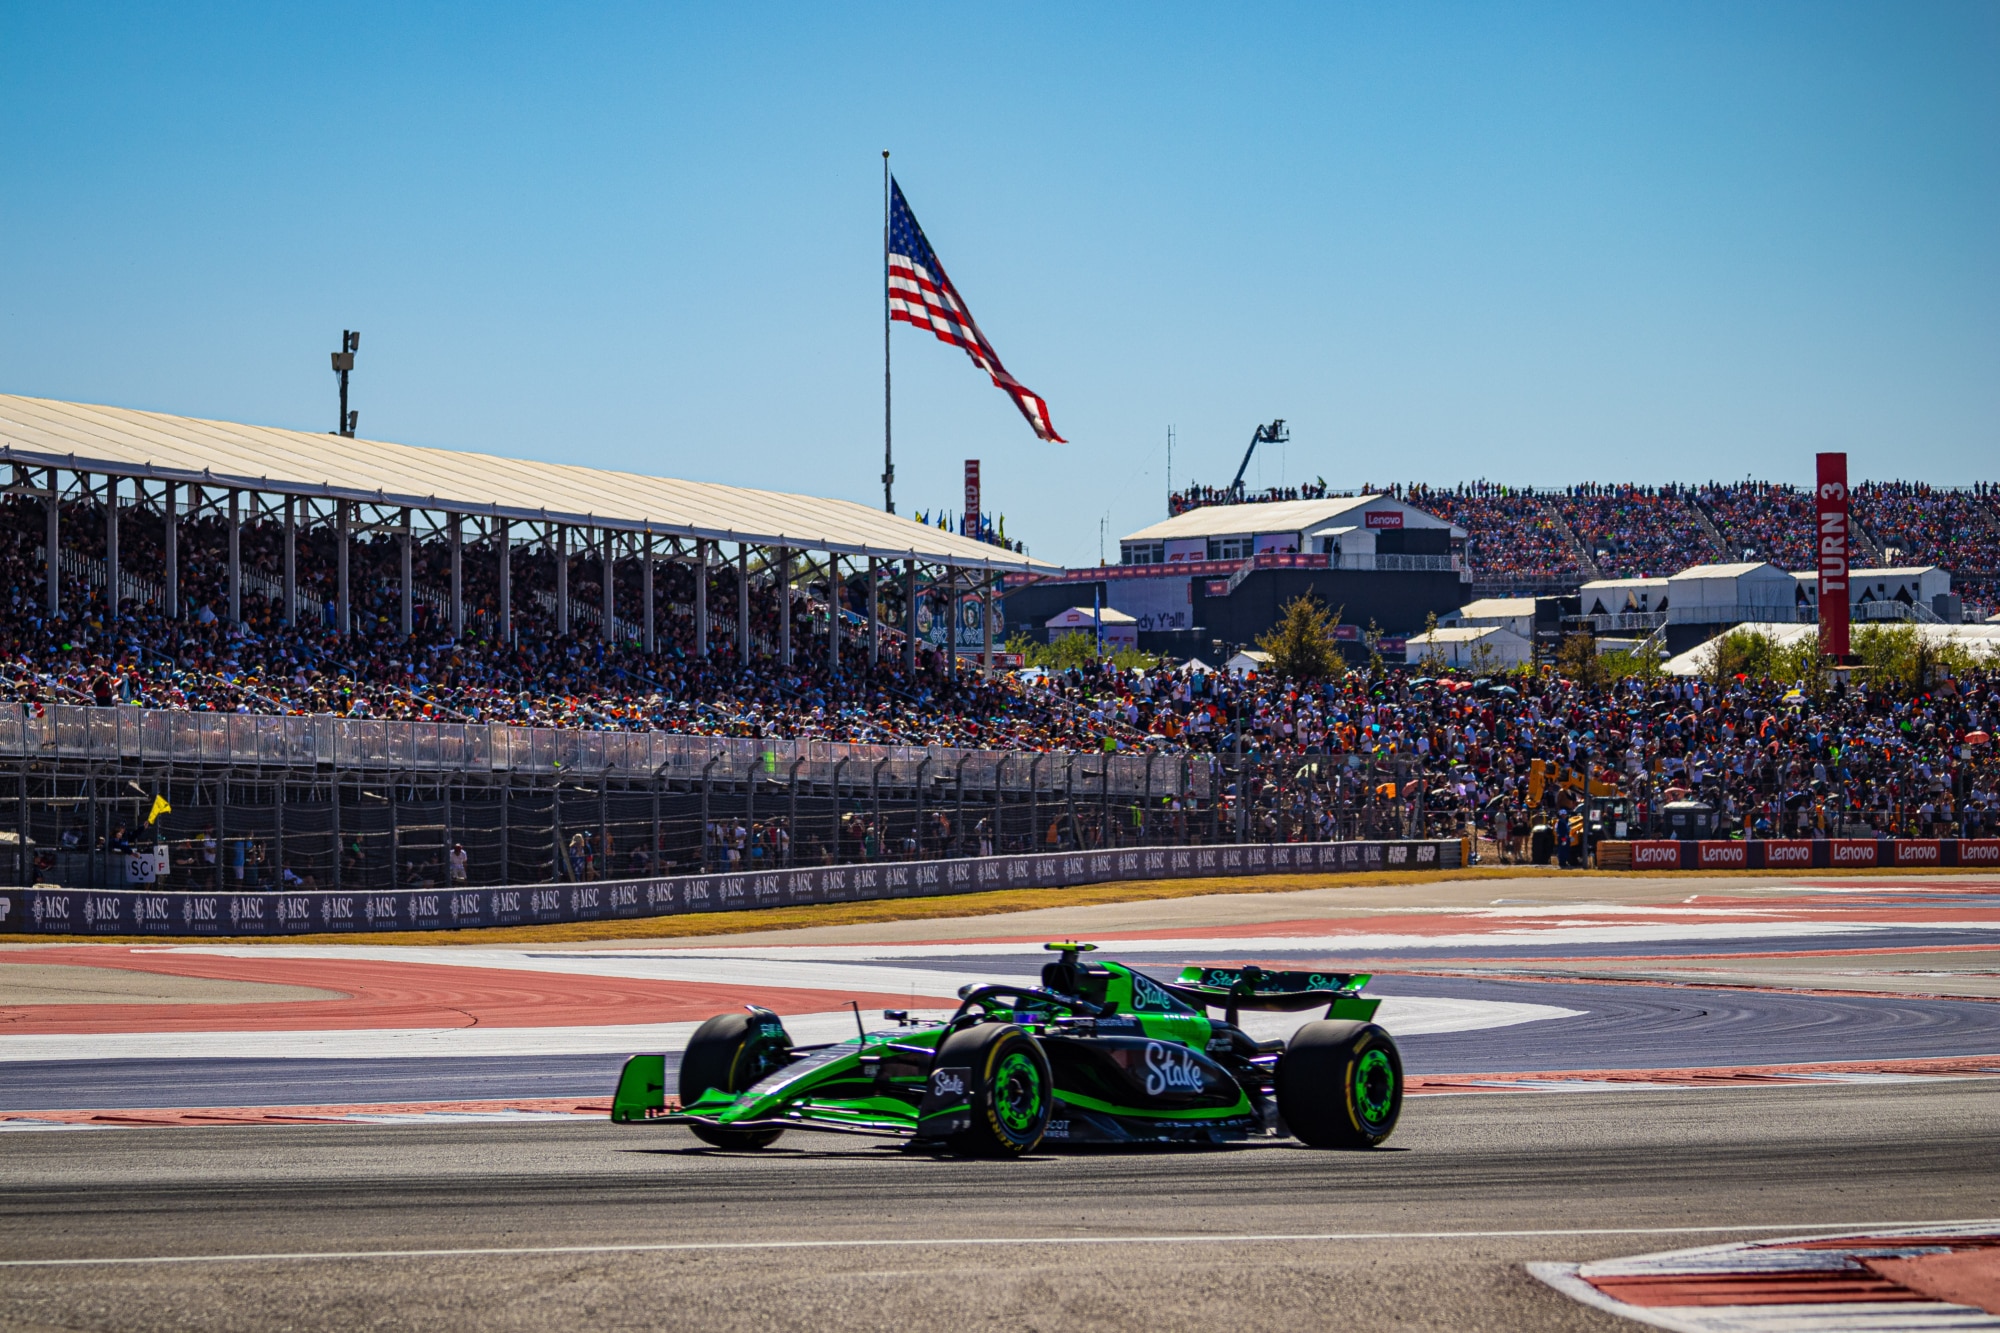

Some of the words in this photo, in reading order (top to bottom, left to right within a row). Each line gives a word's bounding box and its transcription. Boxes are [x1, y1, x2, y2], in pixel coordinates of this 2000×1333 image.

[966, 485, 978, 514] RED
[1820, 482, 1845, 501] 3
[1368, 515, 1401, 526] Lenovo
[1821, 512, 1846, 595] TURN
[158, 848, 164, 856] 4
[1635, 844, 1676, 862] Lenovo
[1702, 844, 1743, 862] Lenovo
[1769, 844, 1809, 861] Lenovo
[1834, 844, 1874, 860] Lenovo
[1898, 843, 1937, 860] Lenovo
[1962, 843, 1999, 859] Lenovo
[132, 861, 149, 876] SC
[158, 862, 164, 872] F
[894, 868, 908, 885] MSC
[924, 866, 939, 883] MSC
[955, 864, 970, 881] MSC
[985, 862, 1000, 879] MSC
[1014, 861, 1029, 877] MSC
[1042, 859, 1056, 876] MSC
[728, 878, 745, 897] MSC
[762, 875, 780, 894] MSC
[796, 873, 814, 891] MSC
[829, 871, 846, 889] MSC
[862, 870, 878, 887] MSC
[581, 888, 600, 908] MSC
[619, 885, 638, 905] MSC
[656, 883, 674, 902] MSC
[692, 880, 710, 899] MSC
[46, 896, 70, 918] MSC
[97, 898, 120, 920] MSC
[146, 898, 168, 919] MSC
[195, 898, 217, 920] MSC
[241, 897, 264, 919] MSC
[288, 898, 310, 918] MSC
[333, 898, 353, 918] MSC
[376, 897, 396, 917] MSC
[419, 896, 439, 916] MSC
[460, 894, 480, 914] MSC
[502, 892, 520, 911] MSC
[541, 890, 560, 909] MSC
[1134, 976, 1171, 1010] Stake
[1145, 1042, 1204, 1096] Stake
[934, 1071, 964, 1096] Stake
